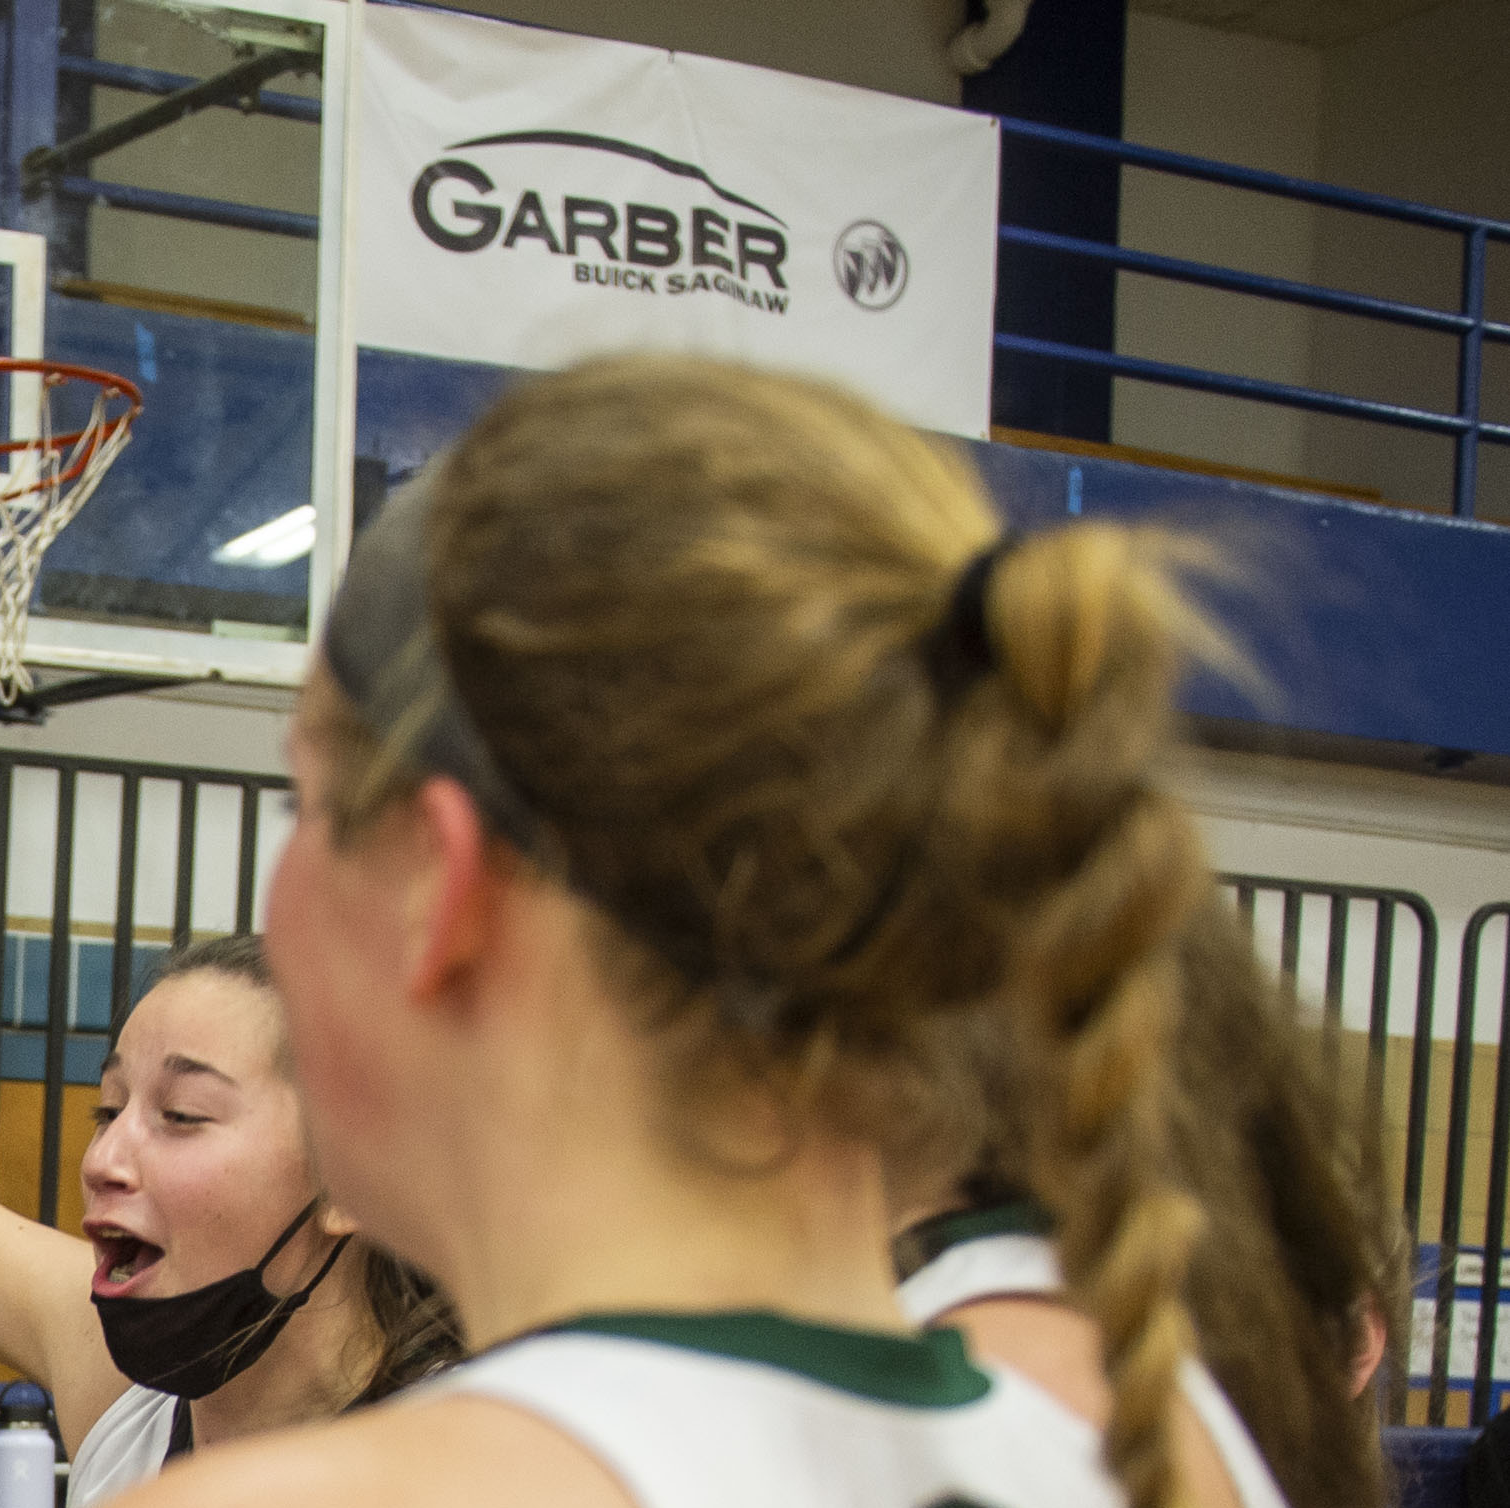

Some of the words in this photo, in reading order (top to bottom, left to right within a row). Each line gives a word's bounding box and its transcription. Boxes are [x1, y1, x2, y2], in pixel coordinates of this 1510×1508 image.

[411, 159, 790, 289] GARBER
[574, 262, 656, 294] BUICK
[666, 271, 788, 314] SAGINAW
